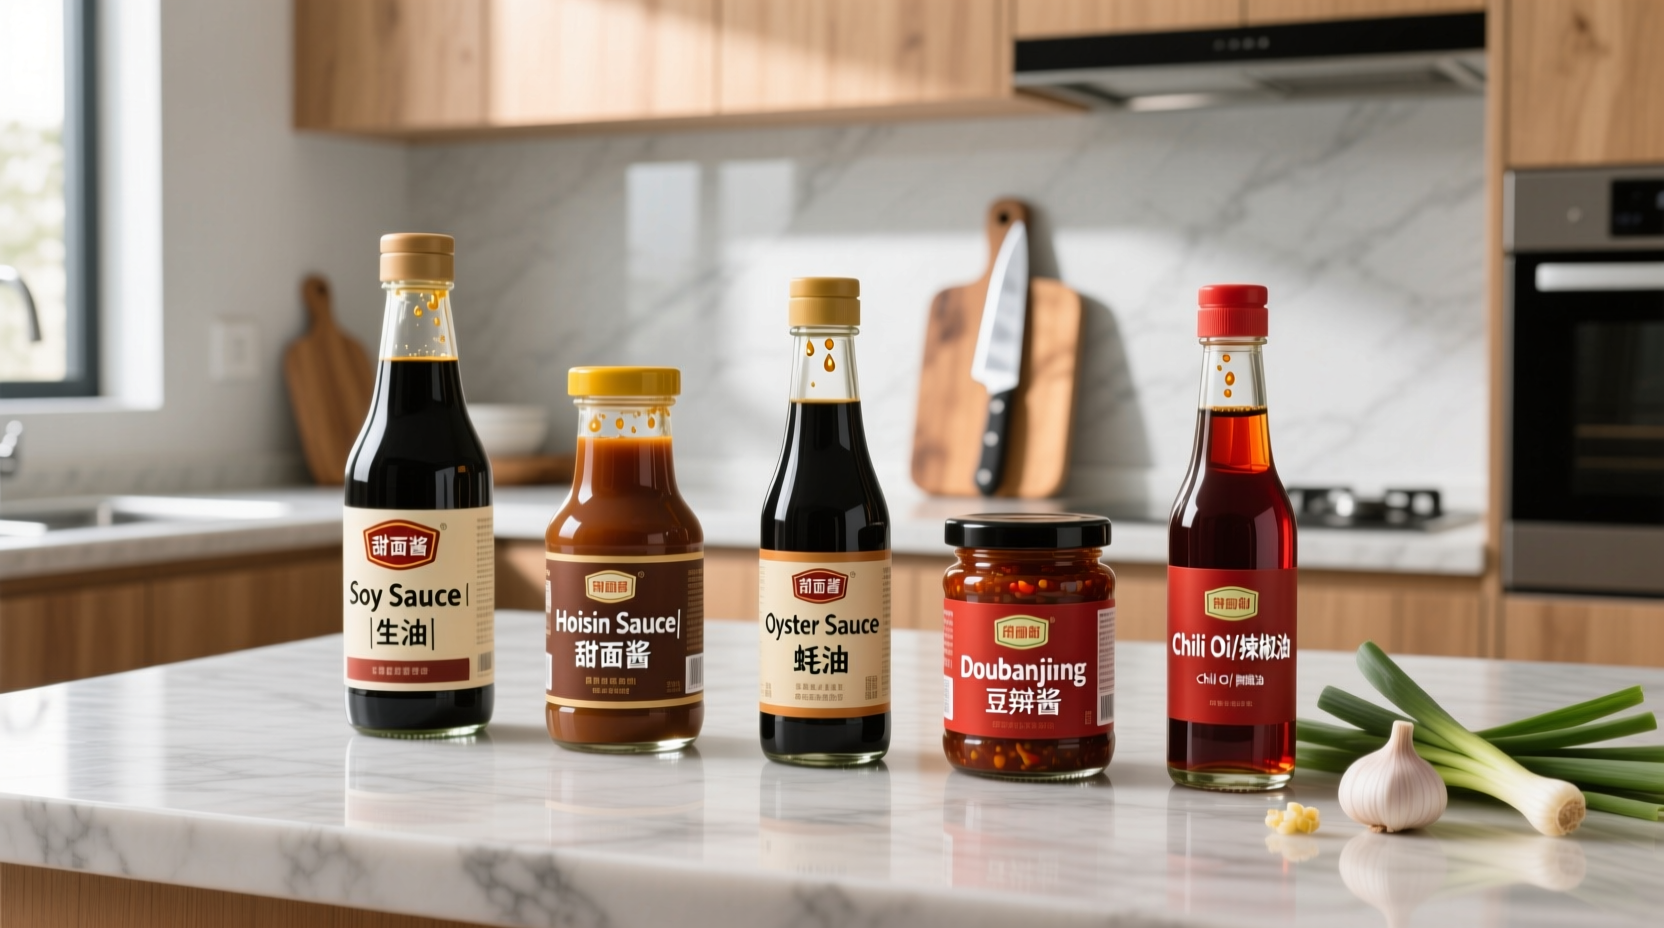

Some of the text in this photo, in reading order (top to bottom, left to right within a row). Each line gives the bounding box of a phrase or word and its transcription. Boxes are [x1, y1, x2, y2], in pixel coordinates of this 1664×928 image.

[350, 580, 383, 612] Soy
[556, 609, 610, 634] Hoisin
[765, 612, 880, 641] Oyster Sauce
[575, 640, 652, 669] 甜面酱
[793, 644, 849, 674] 蚝油
[1172, 632, 1206, 658] Chili
